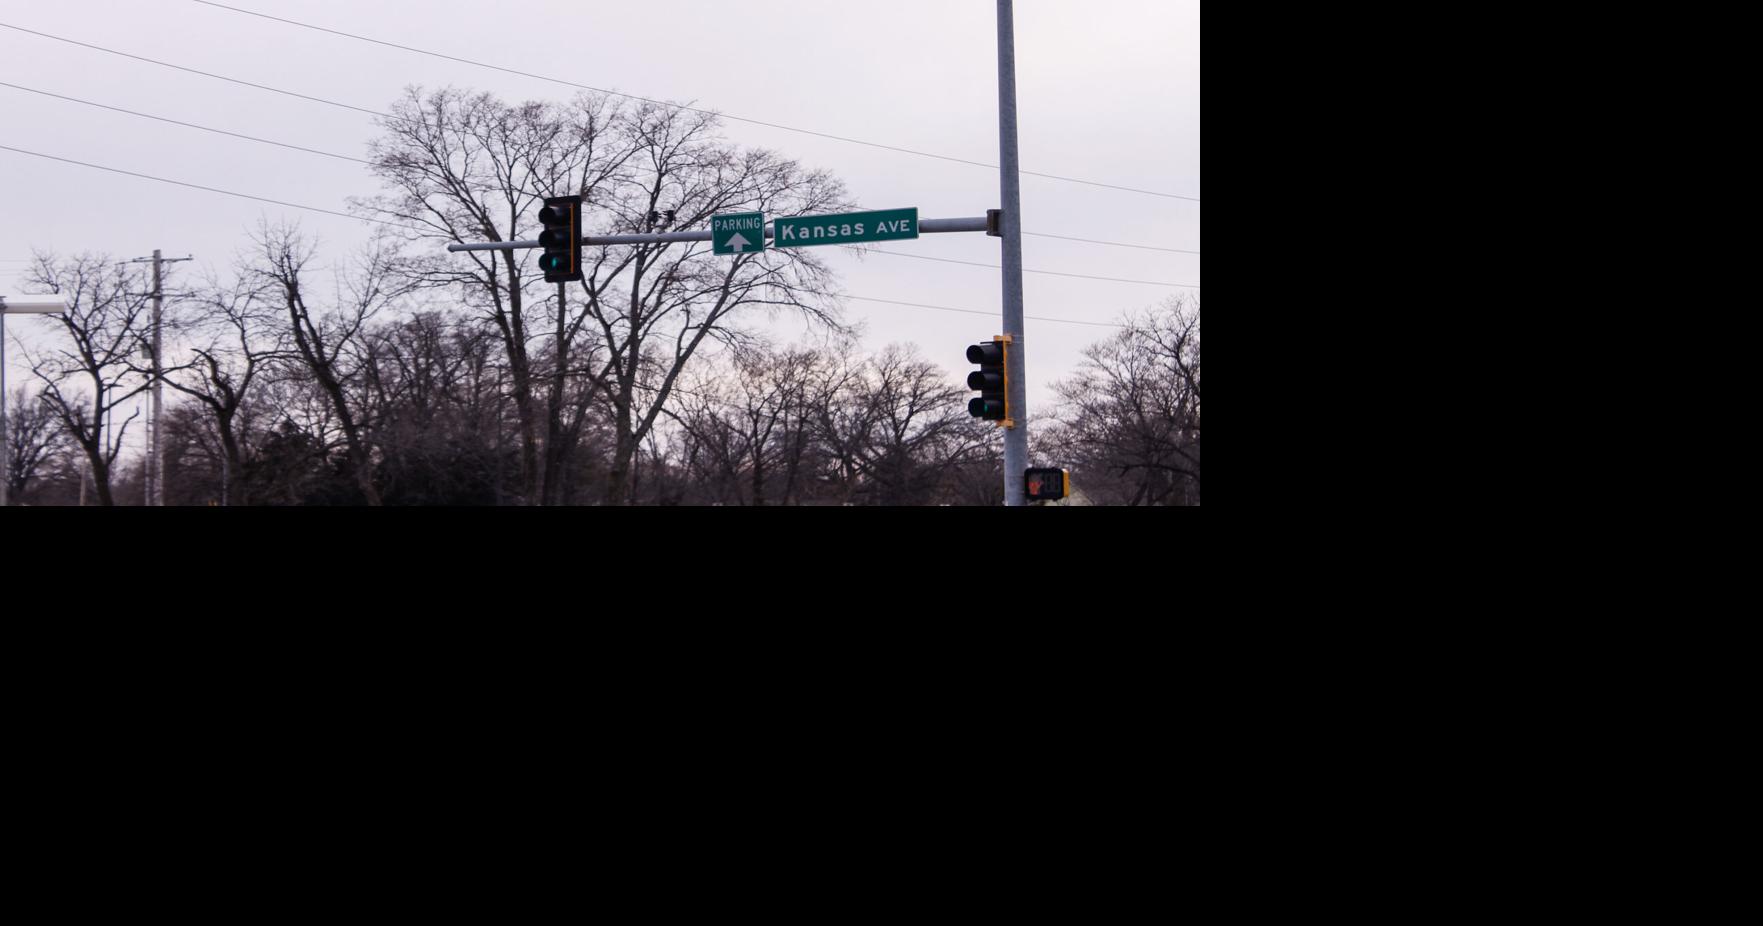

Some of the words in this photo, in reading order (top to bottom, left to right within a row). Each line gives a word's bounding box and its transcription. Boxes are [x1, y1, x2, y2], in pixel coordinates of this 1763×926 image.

[714, 217, 761, 231] PARKING
[781, 222, 865, 240] Kansas
[875, 219, 911, 234] AVE
